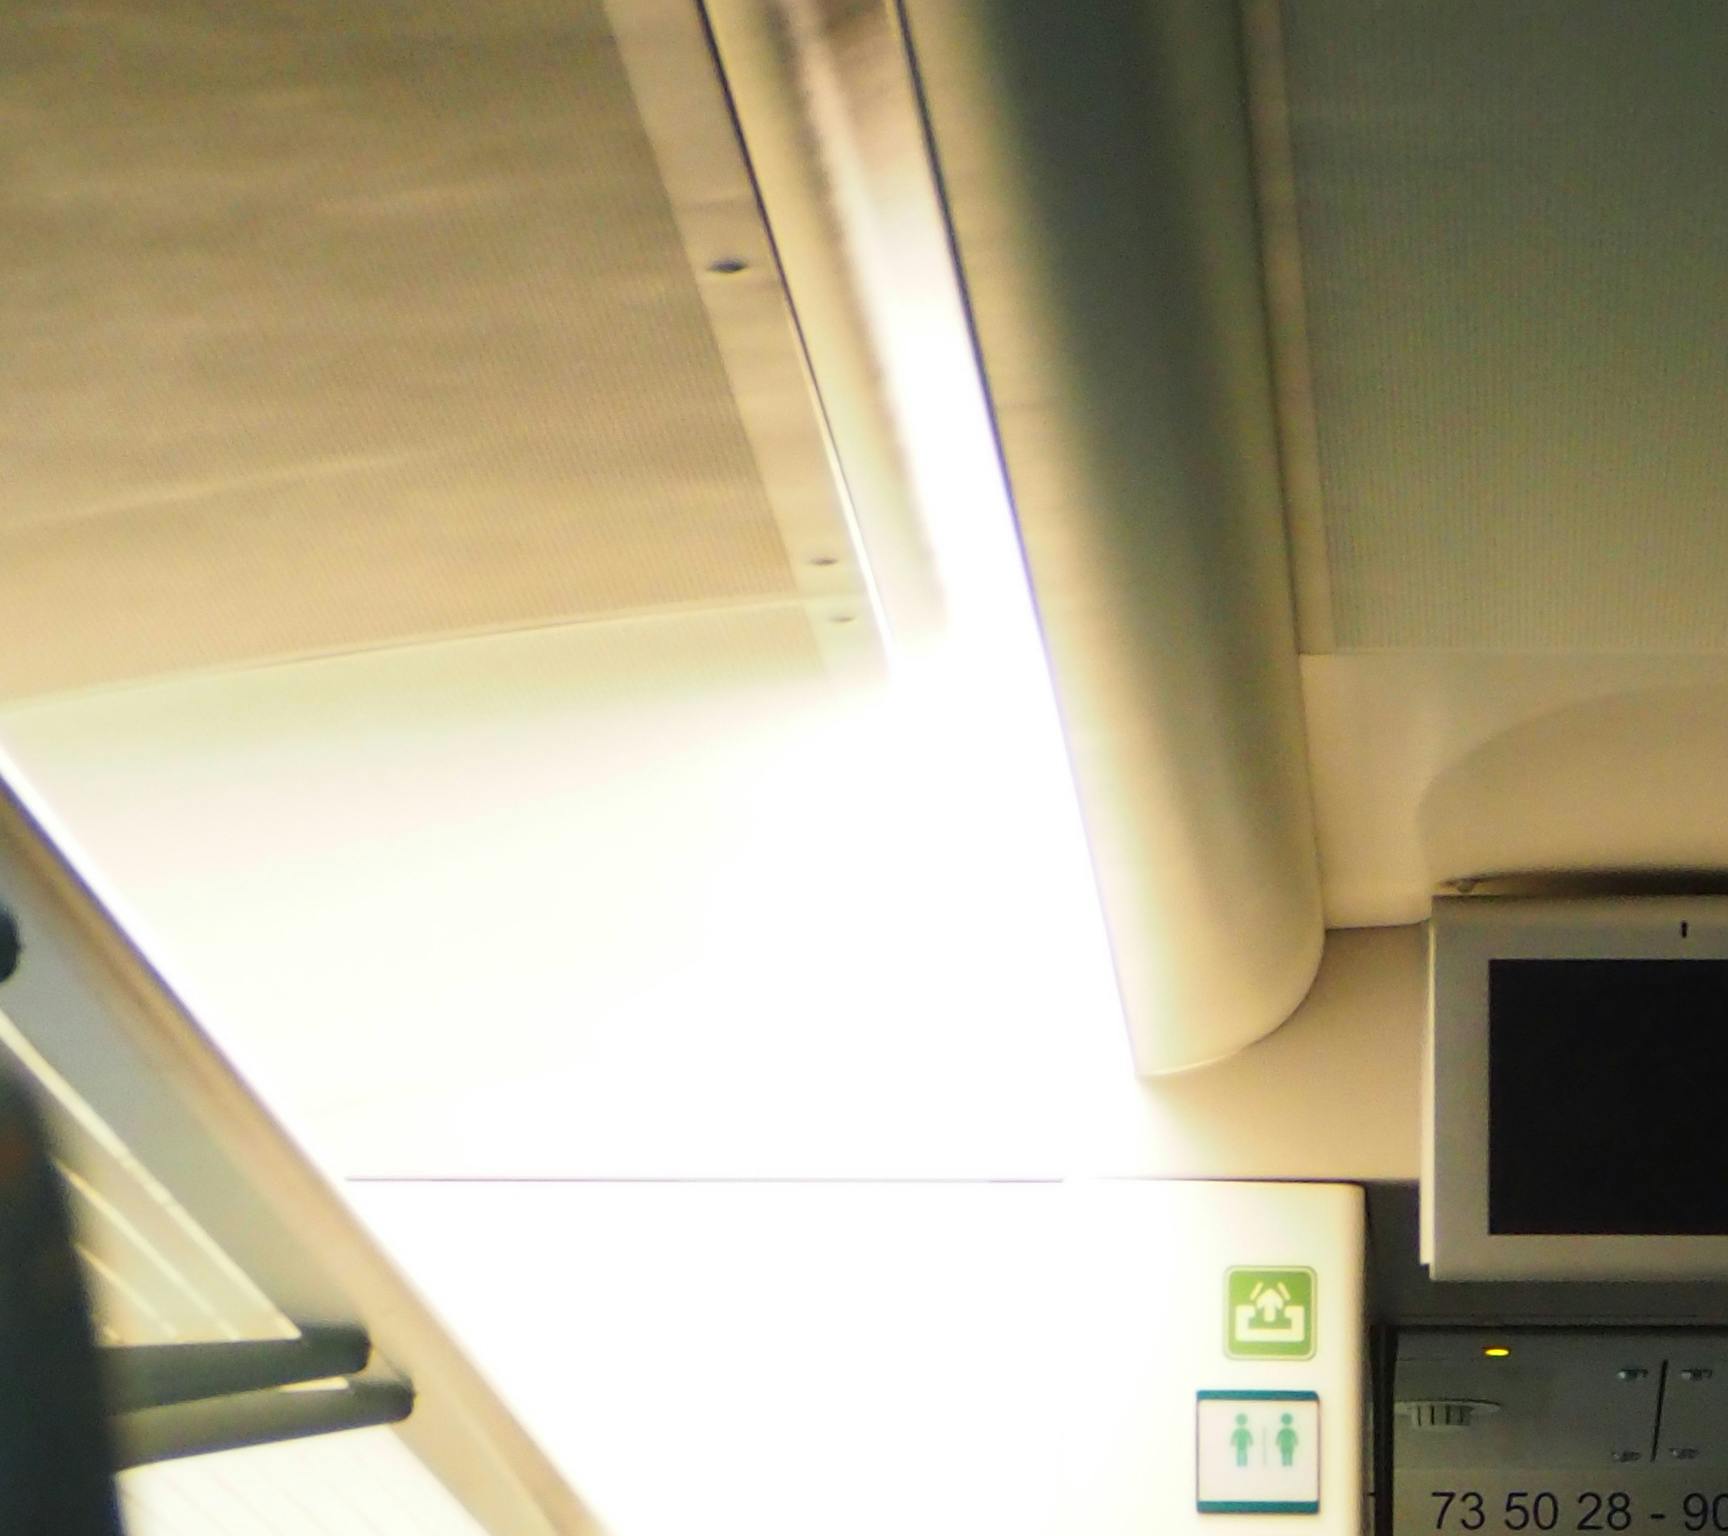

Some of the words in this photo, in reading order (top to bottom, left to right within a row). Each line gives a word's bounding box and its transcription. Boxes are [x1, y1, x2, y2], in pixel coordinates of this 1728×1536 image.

[1430, 1490, 1486, 1532] 73
[1503, 1491, 1560, 1532] 50
[1575, 1491, 1633, 1532] 28
